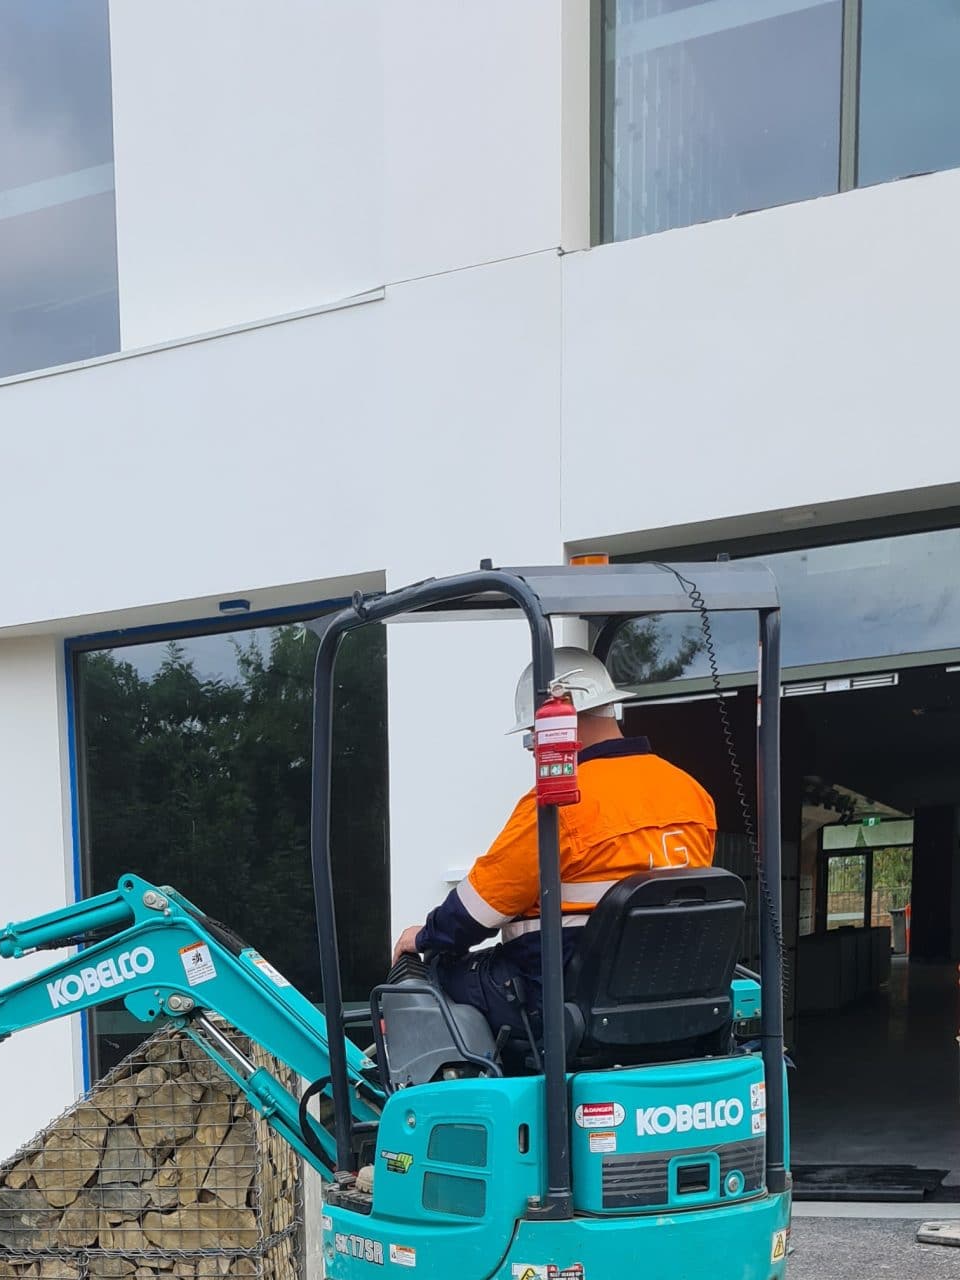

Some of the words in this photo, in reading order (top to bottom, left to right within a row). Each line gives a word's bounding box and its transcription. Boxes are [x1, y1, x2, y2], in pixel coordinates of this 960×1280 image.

[46, 946, 155, 1009] KOBELCO
[589, 1106, 613, 1114] DANGER
[636, 1098, 744, 1136] KOBELCO
